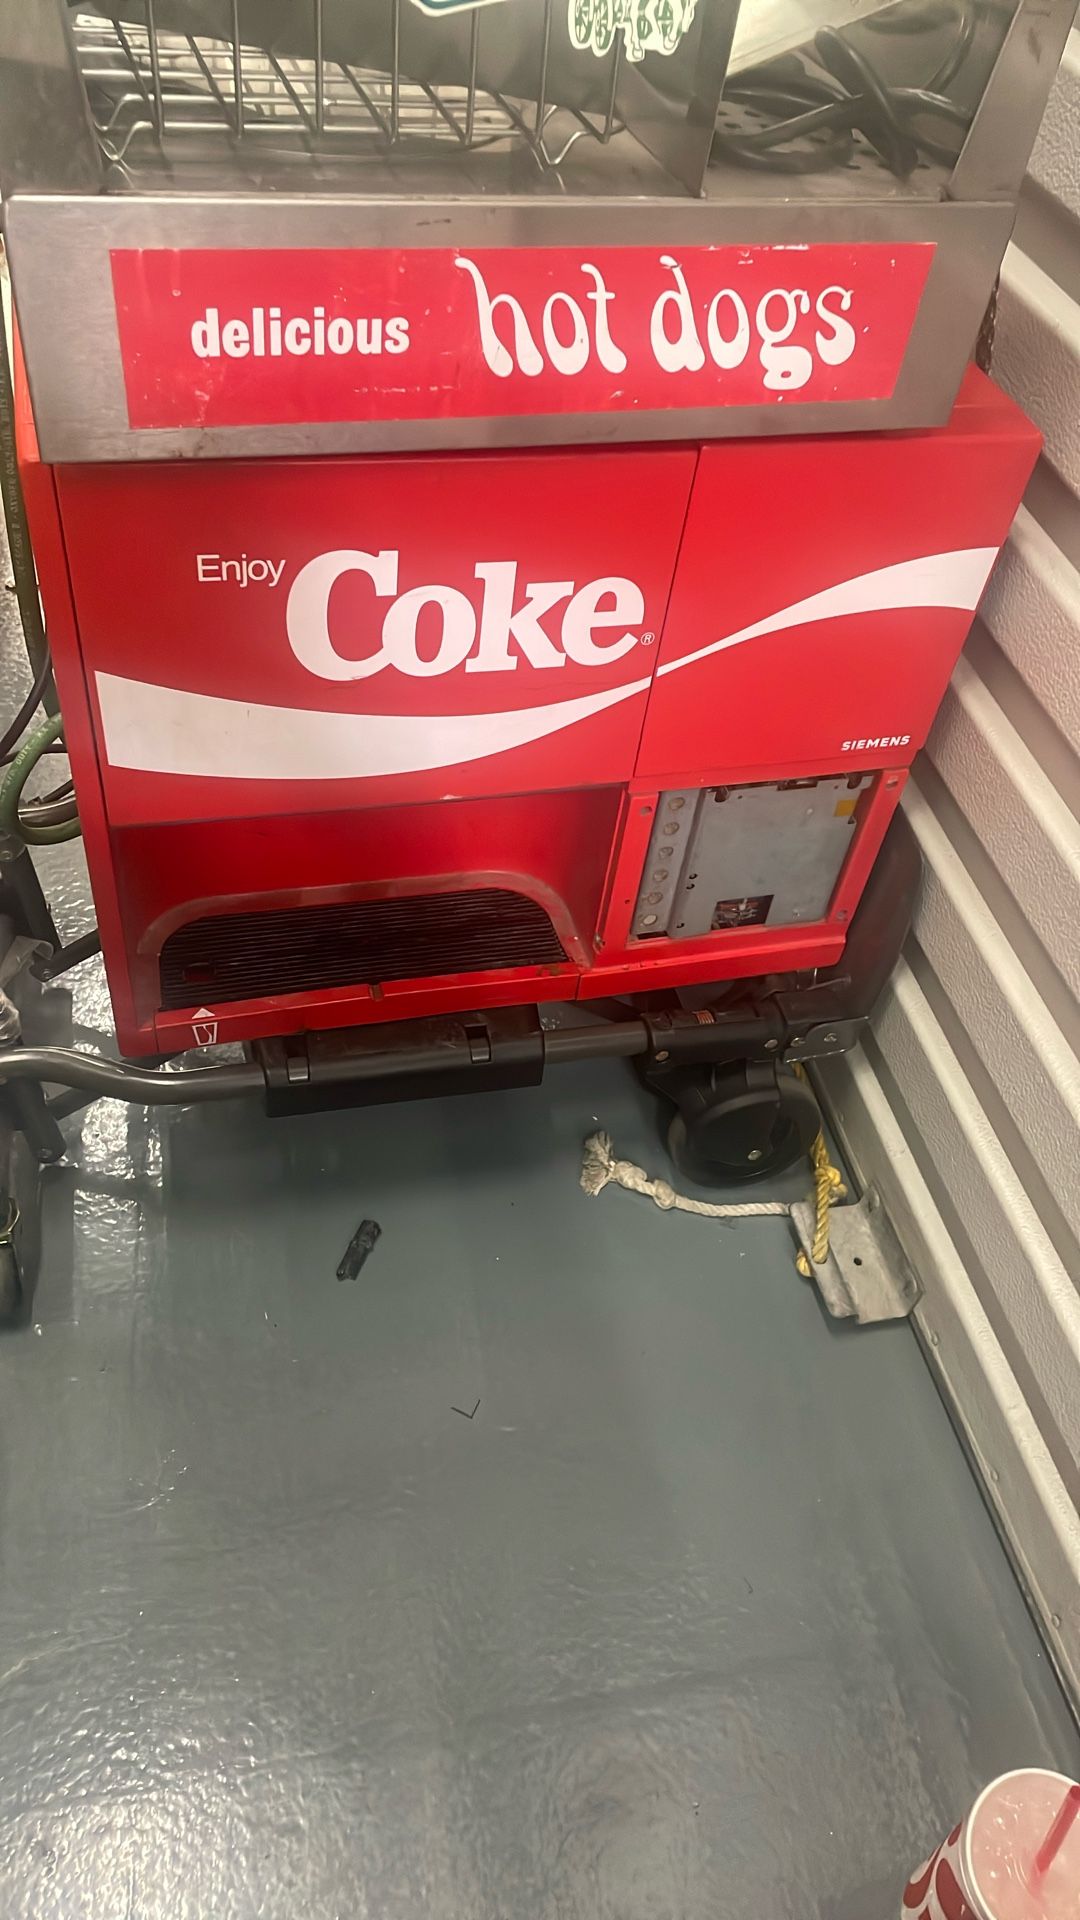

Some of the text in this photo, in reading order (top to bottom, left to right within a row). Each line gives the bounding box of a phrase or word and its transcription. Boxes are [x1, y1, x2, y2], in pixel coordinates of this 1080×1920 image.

[190, 253, 856, 391] delicious hot dogs
[196, 554, 286, 588] Enjoy
[285, 549, 646, 682] Coke
[841, 735, 911, 751] SIEMENS
